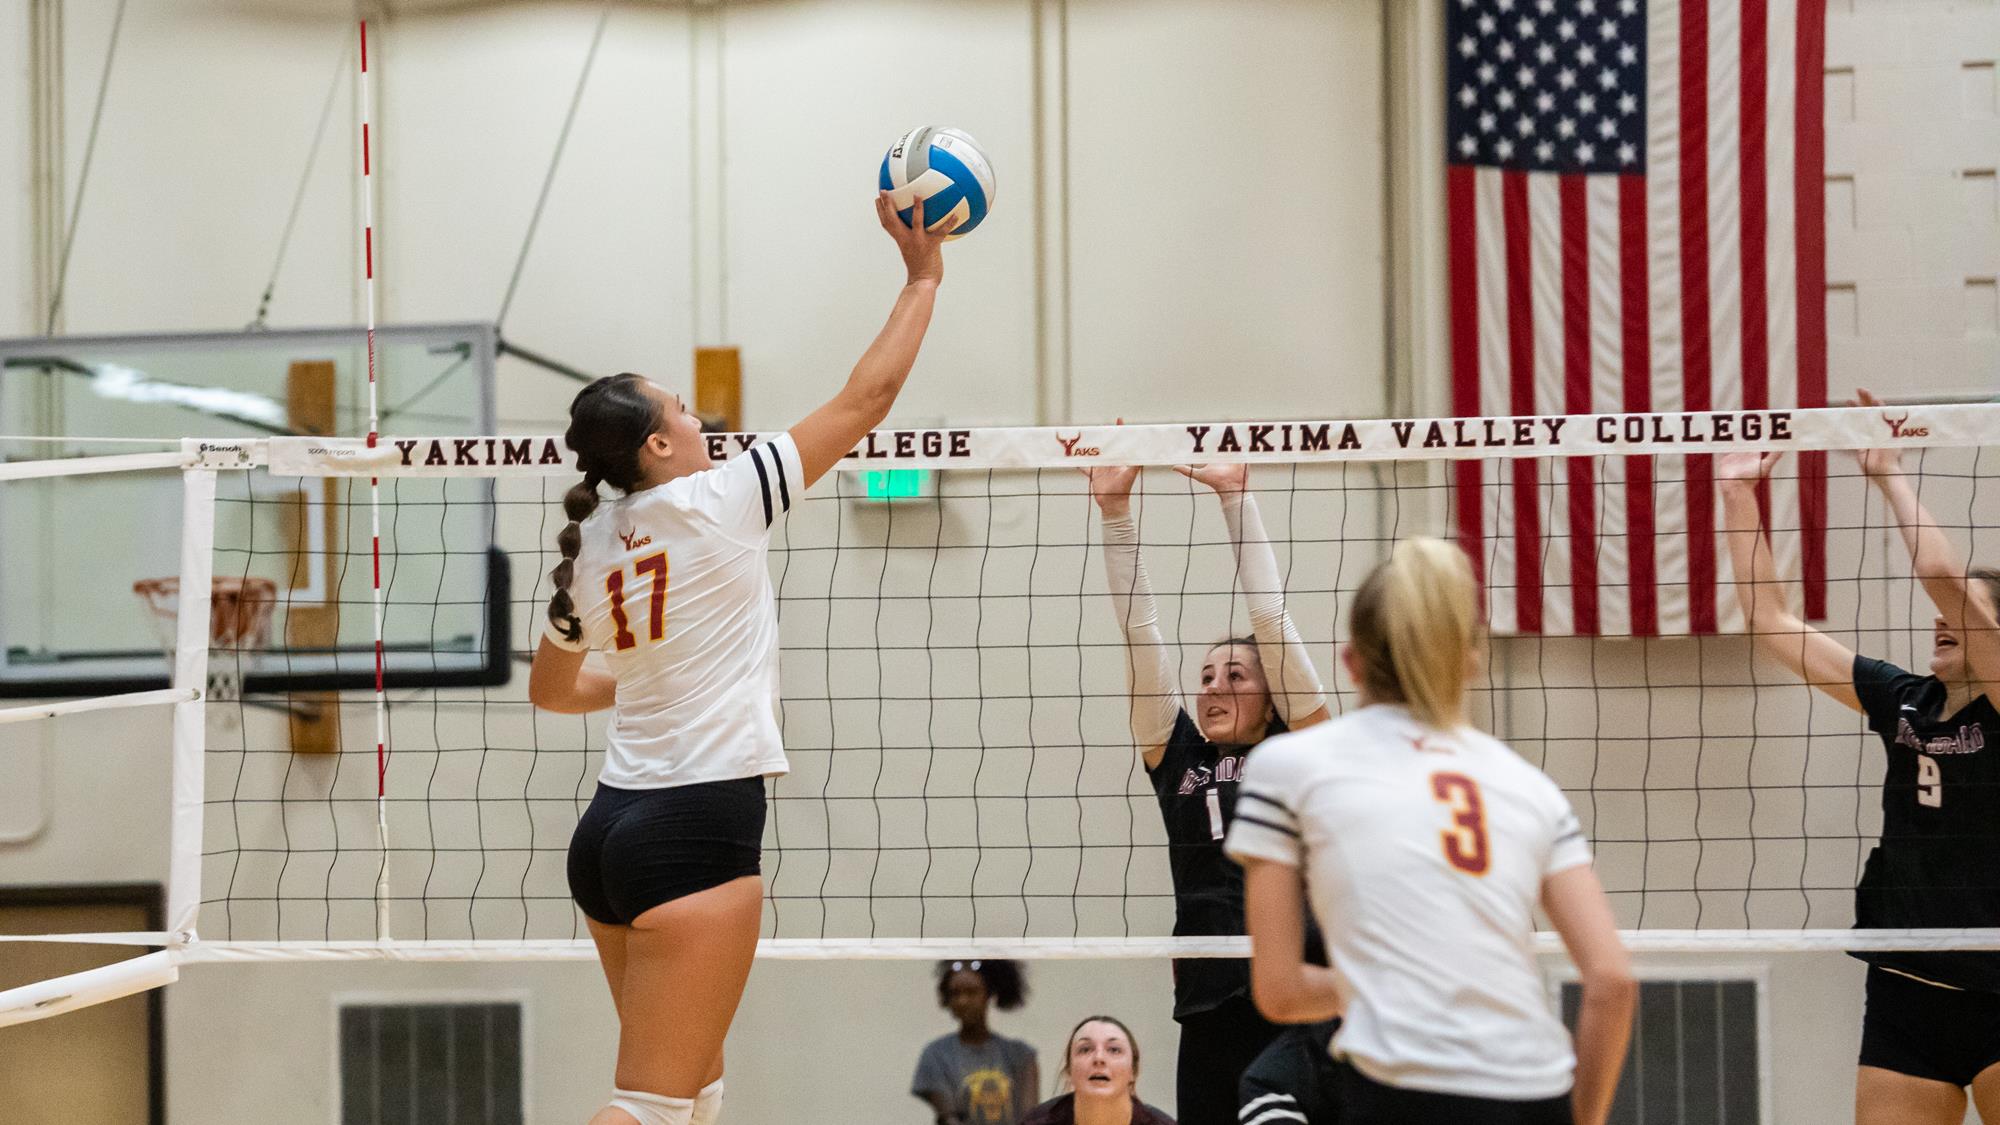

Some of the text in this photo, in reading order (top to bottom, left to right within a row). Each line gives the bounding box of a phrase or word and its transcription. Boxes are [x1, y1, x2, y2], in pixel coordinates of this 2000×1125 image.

[395, 431, 971, 466] YAKIMA LEGE
[1187, 412, 1792, 452] YAKIMA VALLEY COLLEGE
[606, 550, 668, 652] 17
[1917, 754, 1942, 808] 9
[1206, 788, 1224, 840] 1
[1429, 772, 1491, 878] 3
